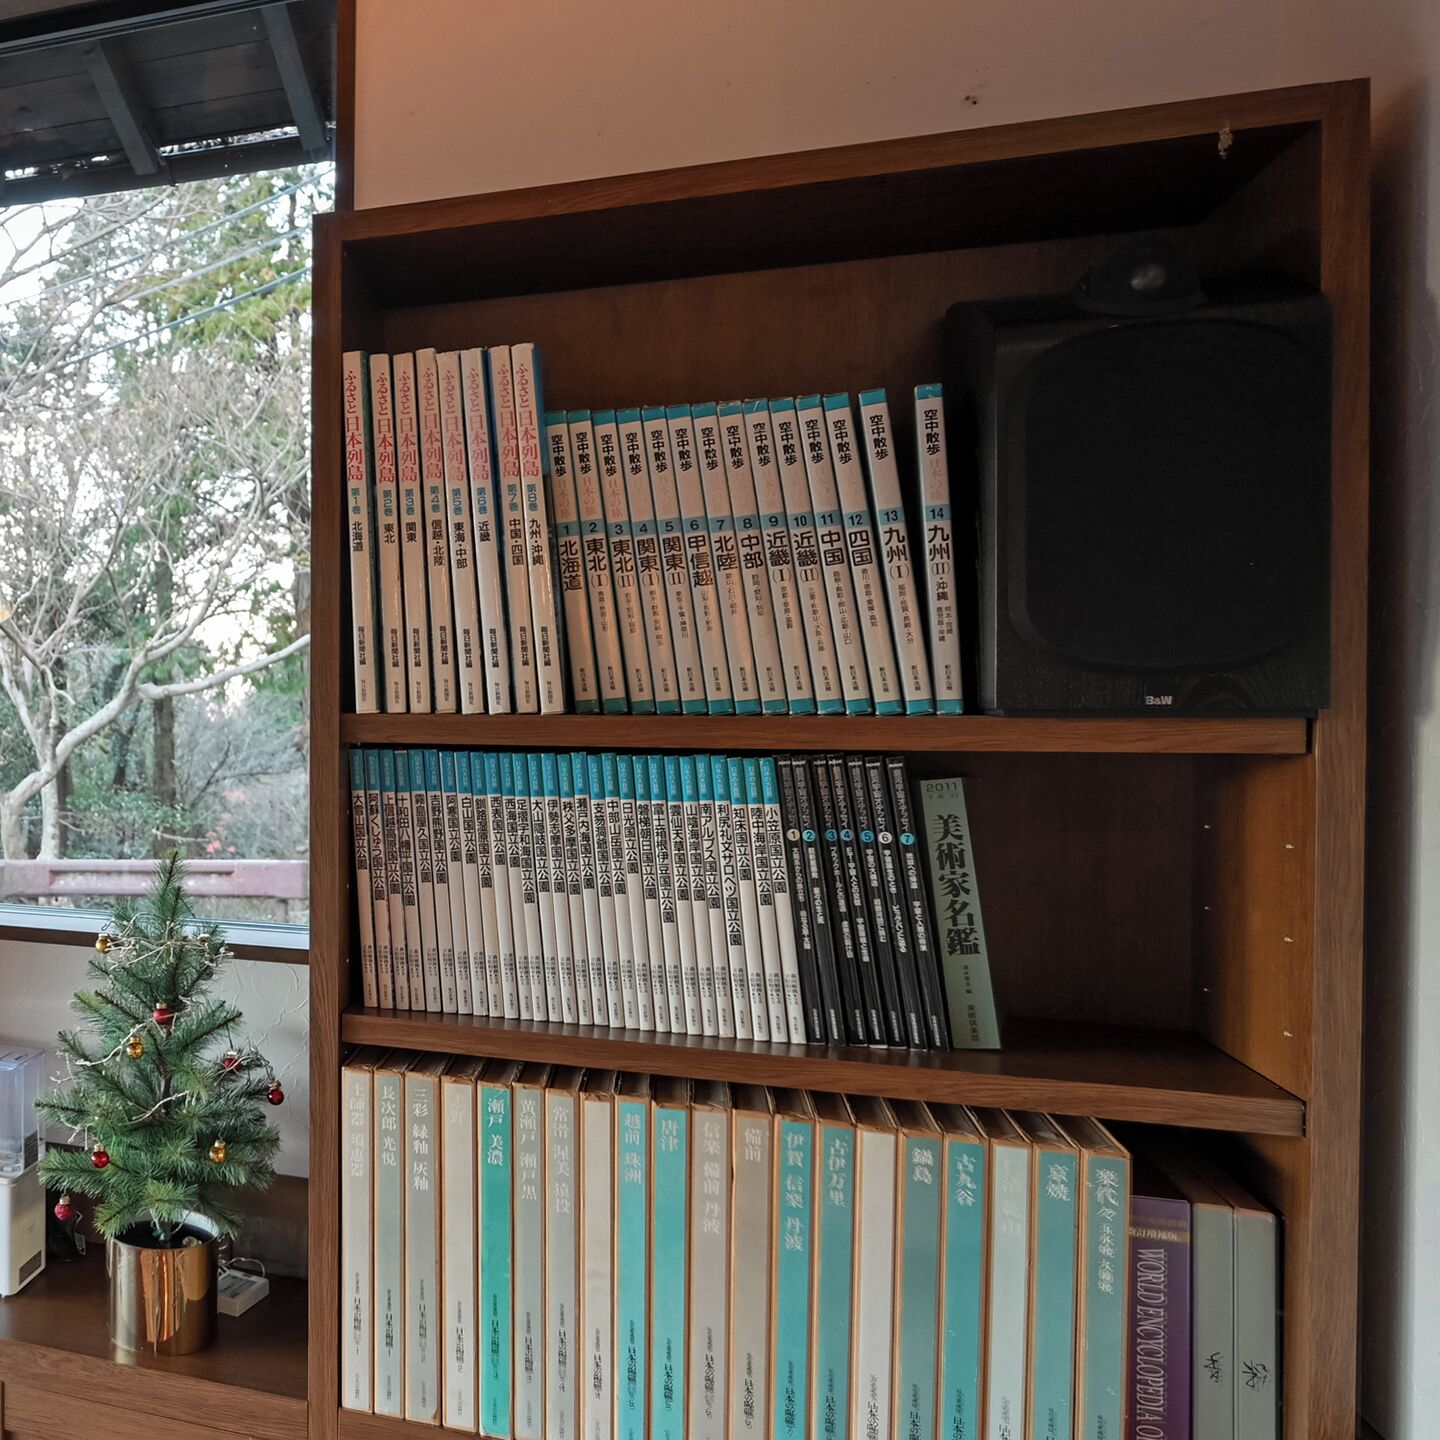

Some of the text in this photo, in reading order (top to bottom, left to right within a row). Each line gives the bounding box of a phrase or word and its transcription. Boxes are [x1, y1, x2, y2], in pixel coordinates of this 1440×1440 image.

[576, 431, 591, 475] 空中散歩
[589, 522, 597, 533] 2
[626, 432, 648, 533] 空中散歩 4
[651, 430, 667, 473] 空中散歩
[665, 521, 673, 532] 5
[675, 428, 692, 472] 空中散歩
[753, 422, 778, 527] 空中散歩 9
[779, 421, 807, 527] 空中散歩 10
[869, 414, 898, 522] 空中散歩 13
[924, 409, 940, 455] 空中散歩
[551, 433, 583, 592] 空中散歩 1 北海道
[601, 433, 623, 535] 空中散歩 3
[690, 519, 699, 531] 6
[701, 427, 738, 570] 空中散歩 7 北陸
[726, 425, 763, 569] 空中散歩 8 中部
[805, 419, 844, 567] 空中散歩 11 中国
[833, 420, 873, 566] 空中散歩 12 四国
[930, 508, 944, 519] 14
[687, 535, 714, 588] 甲信越
[1145, 695, 1172, 705] B&W
[926, 783, 958, 792] 2011
[932, 814, 980, 956] 美術家名鑑
[382, 1086, 396, 1166] 長次郎 光悦
[413, 1089, 428, 1116] 三彩
[488, 1135, 503, 1165] 美濃
[1136, 1249, 1164, 1305] WORLD
[1136, 1308, 1164, 1420] ENCYCLOPEDIA
